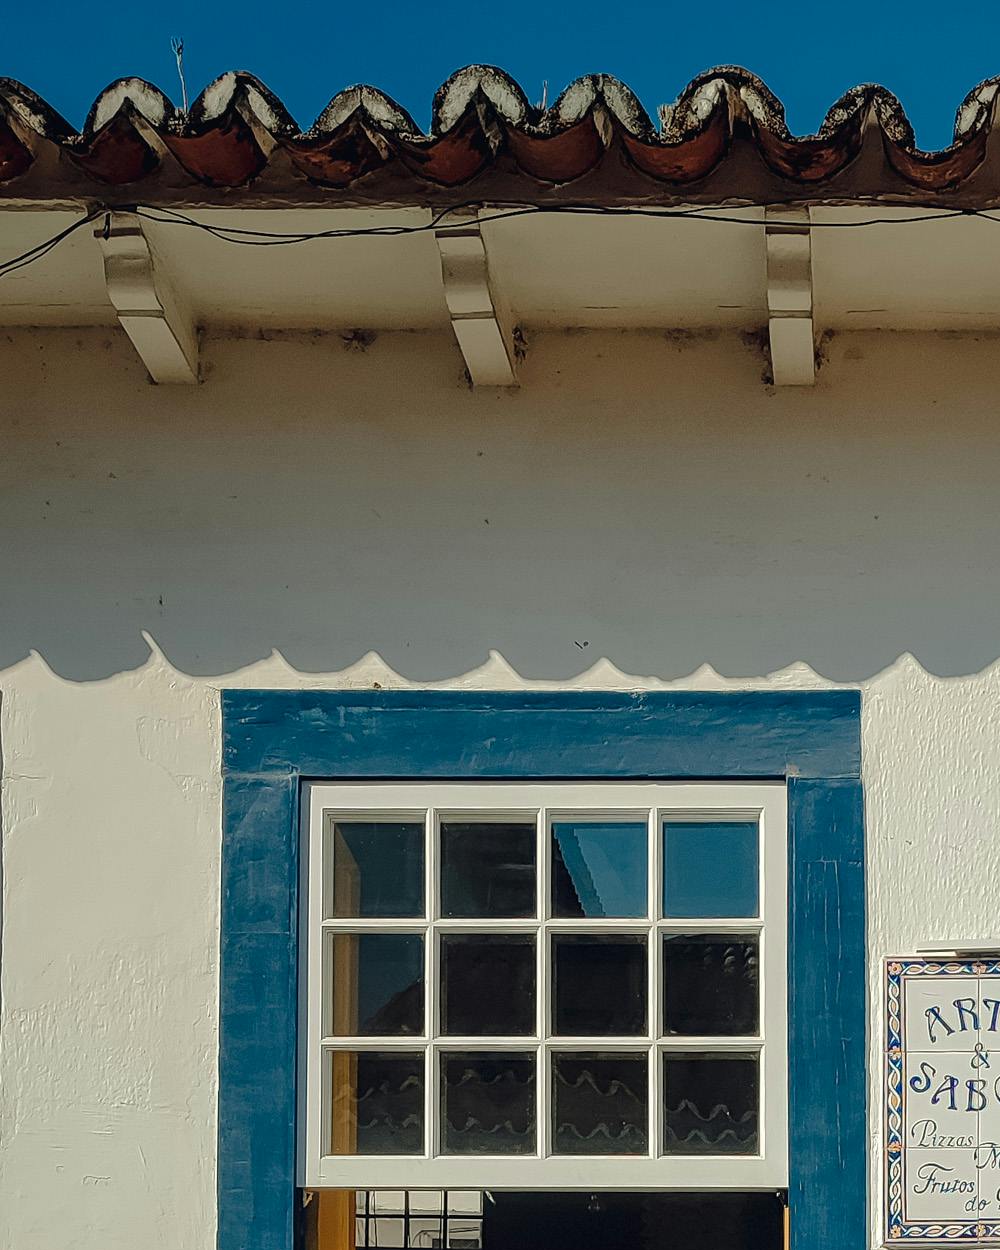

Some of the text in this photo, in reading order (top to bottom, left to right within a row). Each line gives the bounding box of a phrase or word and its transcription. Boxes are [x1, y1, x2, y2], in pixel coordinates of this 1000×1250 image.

[970, 1042, 991, 1069] &
[911, 1119, 974, 1148] Pizzas
[913, 1162, 975, 1194] Frutos
[964, 1194, 991, 1212] do
